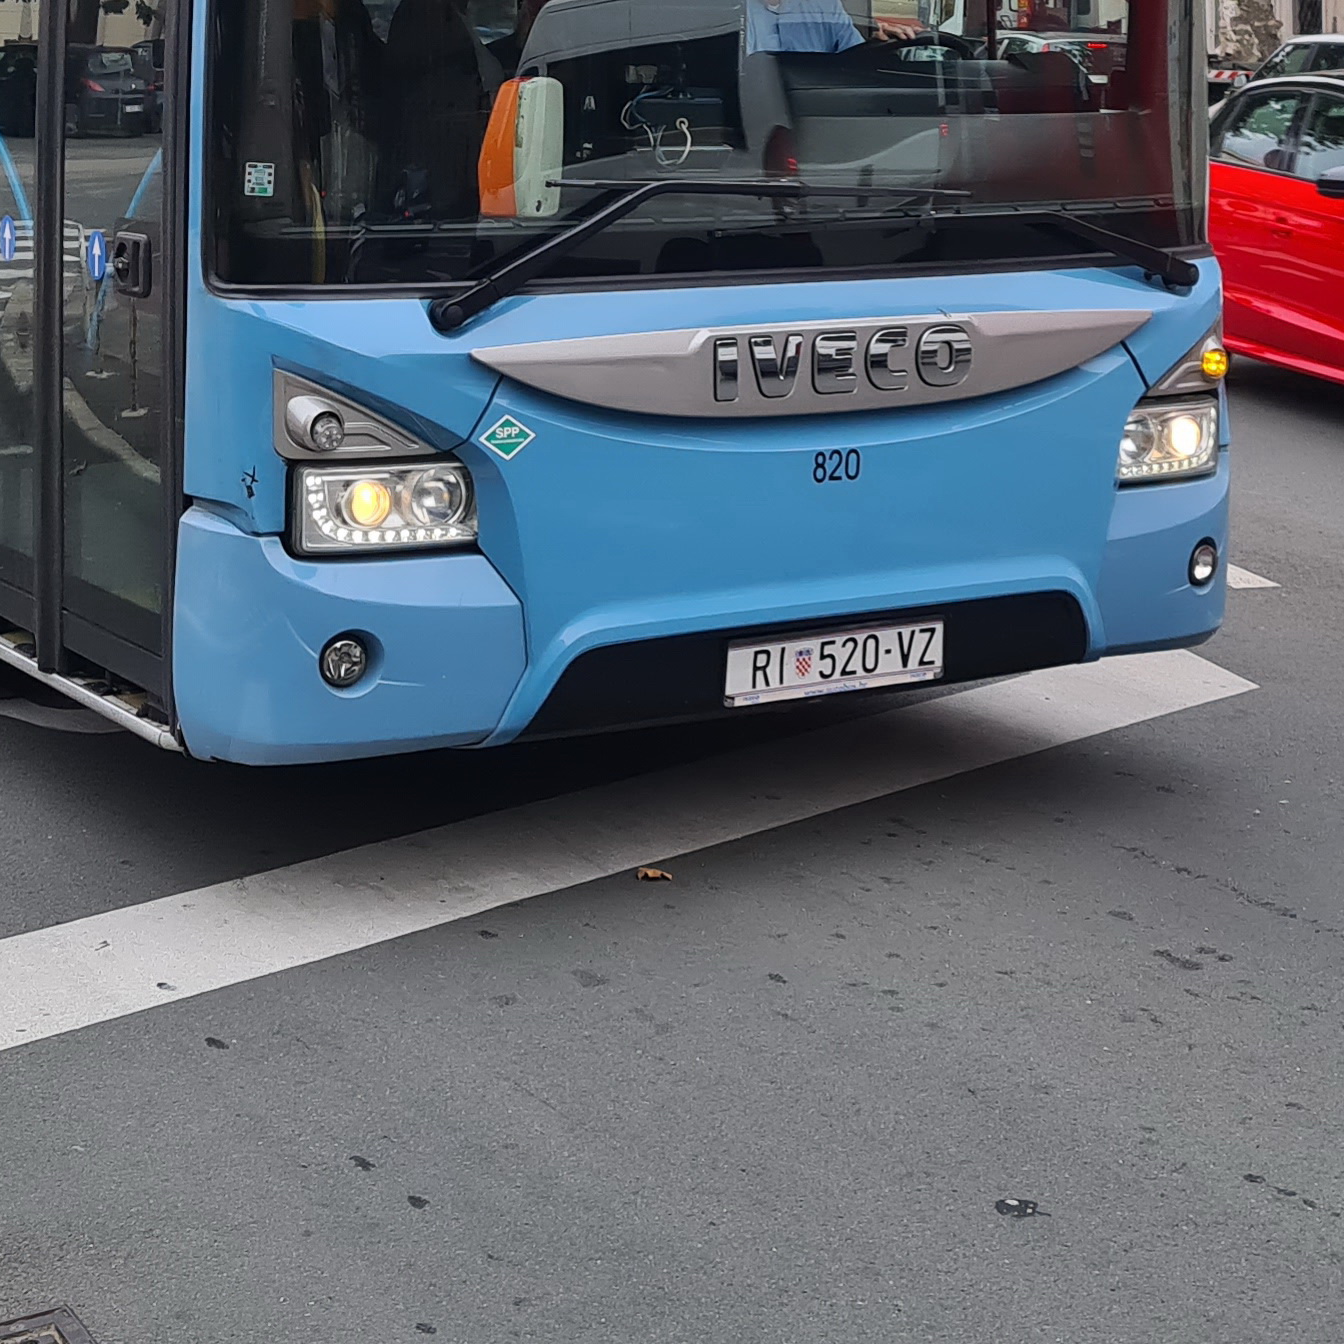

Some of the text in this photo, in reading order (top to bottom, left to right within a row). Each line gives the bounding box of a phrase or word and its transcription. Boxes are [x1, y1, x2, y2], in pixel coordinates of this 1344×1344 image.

[713, 324, 973, 403] IVECO
[495, 426, 520, 439] SPP
[812, 448, 861, 484] 820
[751, 626, 937, 689] RI 520-VZ
